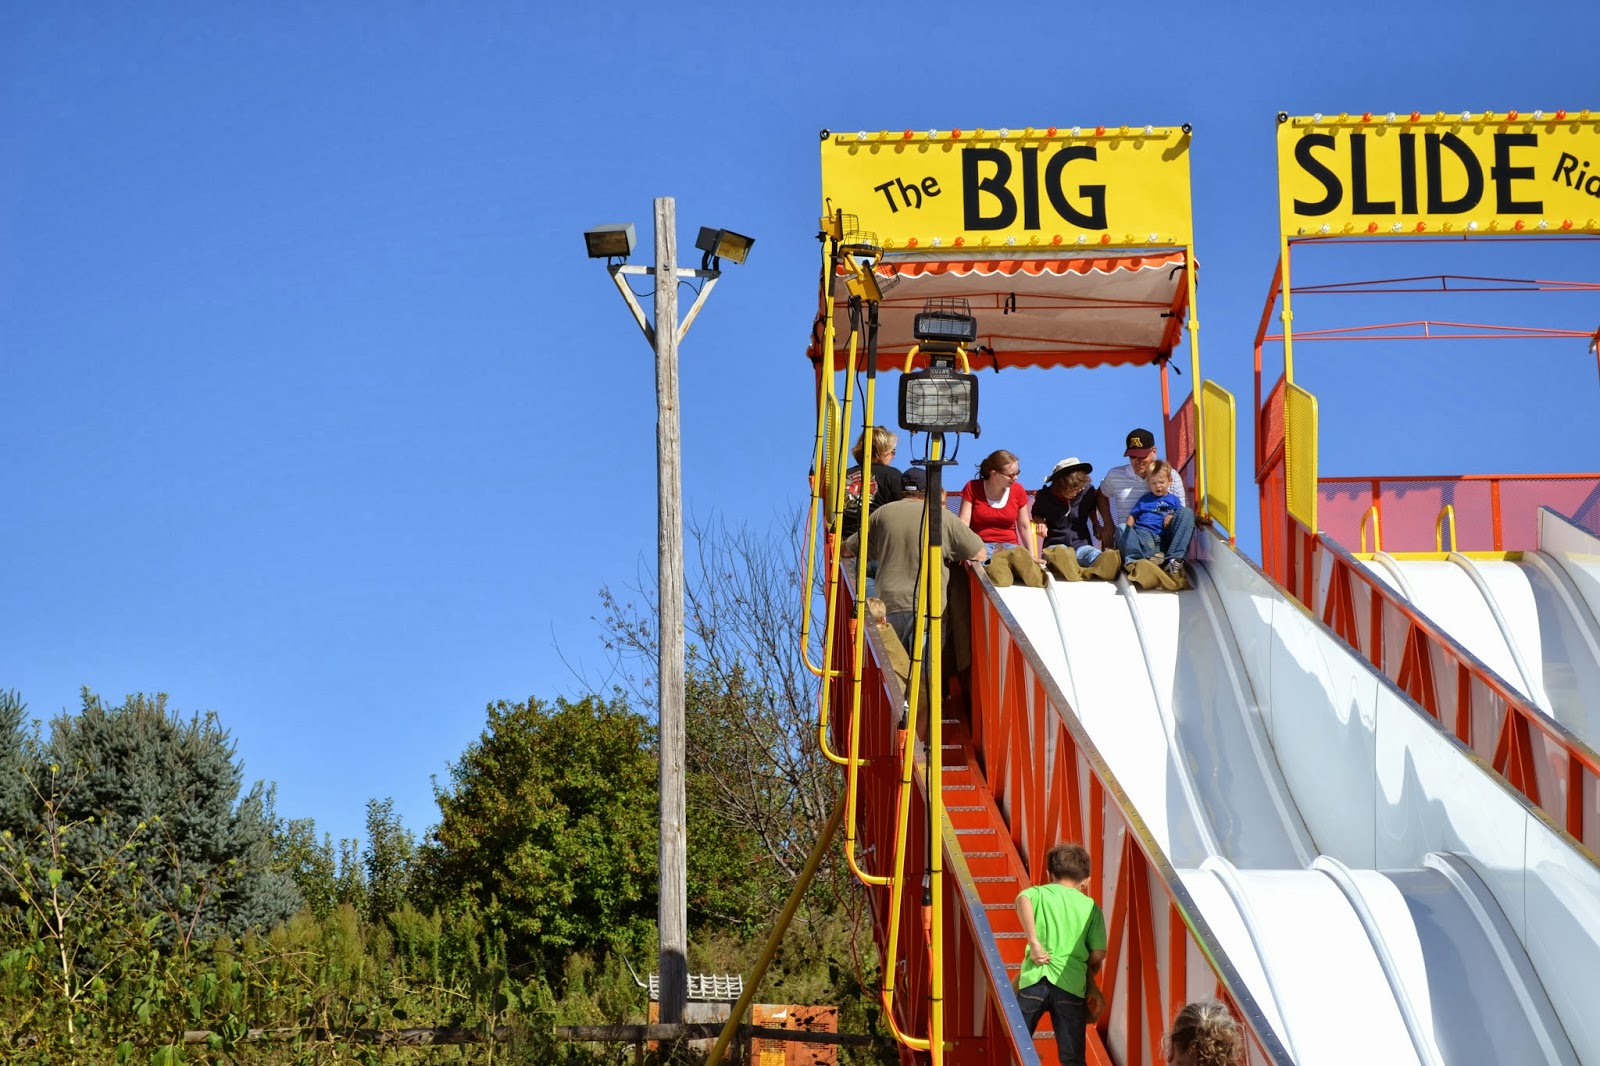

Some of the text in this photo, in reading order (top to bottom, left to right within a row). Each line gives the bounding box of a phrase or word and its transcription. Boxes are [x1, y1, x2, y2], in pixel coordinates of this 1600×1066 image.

[873, 145, 1109, 231] The BIG
[1293, 131, 1545, 217] SLIDE
